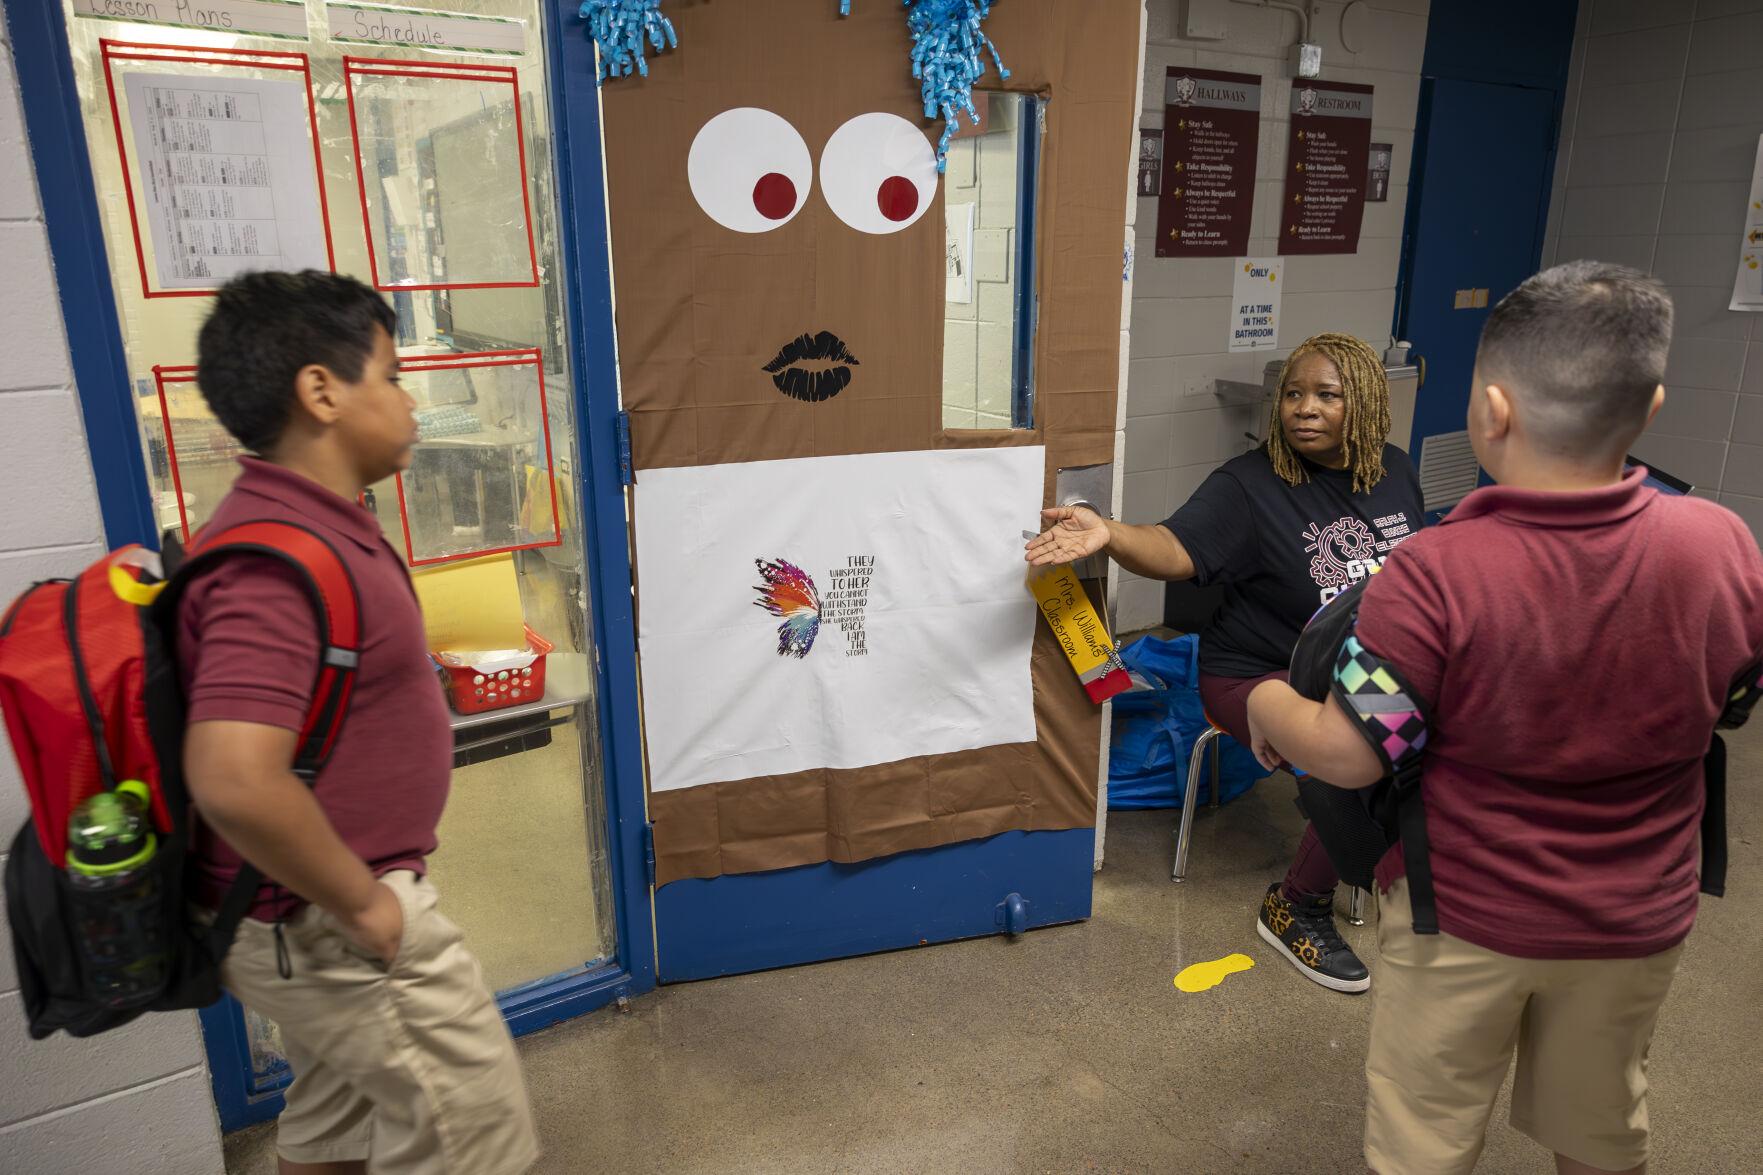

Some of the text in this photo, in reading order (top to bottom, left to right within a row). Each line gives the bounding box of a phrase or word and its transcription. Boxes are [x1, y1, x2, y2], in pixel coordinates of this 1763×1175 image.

[91, 0, 233, 28] Lesson Plans
[354, 10, 444, 45] Schedule
[1197, 87, 1246, 103] HALLWAYS
[1317, 97, 1361, 111] RESTROOM
[1185, 162, 1233, 173] Take Responsibility
[1185, 189, 1236, 199] Always be Respectful
[1181, 230, 1197, 240] Ready
[1204, 230, 1220, 238] Learn
[1250, 268, 1269, 278] ONLY
[1240, 304, 1272, 315] AT A TIME
[1243, 316, 1268, 326] IN THIS
[1235, 328, 1273, 339] BATHROOM
[848, 555, 875, 567] THEY
[829, 567, 874, 578] WHISPERED
[831, 576, 870, 590] TO HER
[825, 589, 869, 600] YOU CANNOT
[1054, 575, 1076, 611] Mrs.
[822, 598, 868, 610] WITHSTAND
[823, 607, 864, 618] THE STORM
[822, 615, 865, 625] SHE WHISPERED
[841, 621, 865, 632] BACK
[1042, 597, 1079, 660] Classroom
[851, 630, 866, 641] AM
[851, 639, 867, 649] THE
[845, 648, 868, 658] STORM
